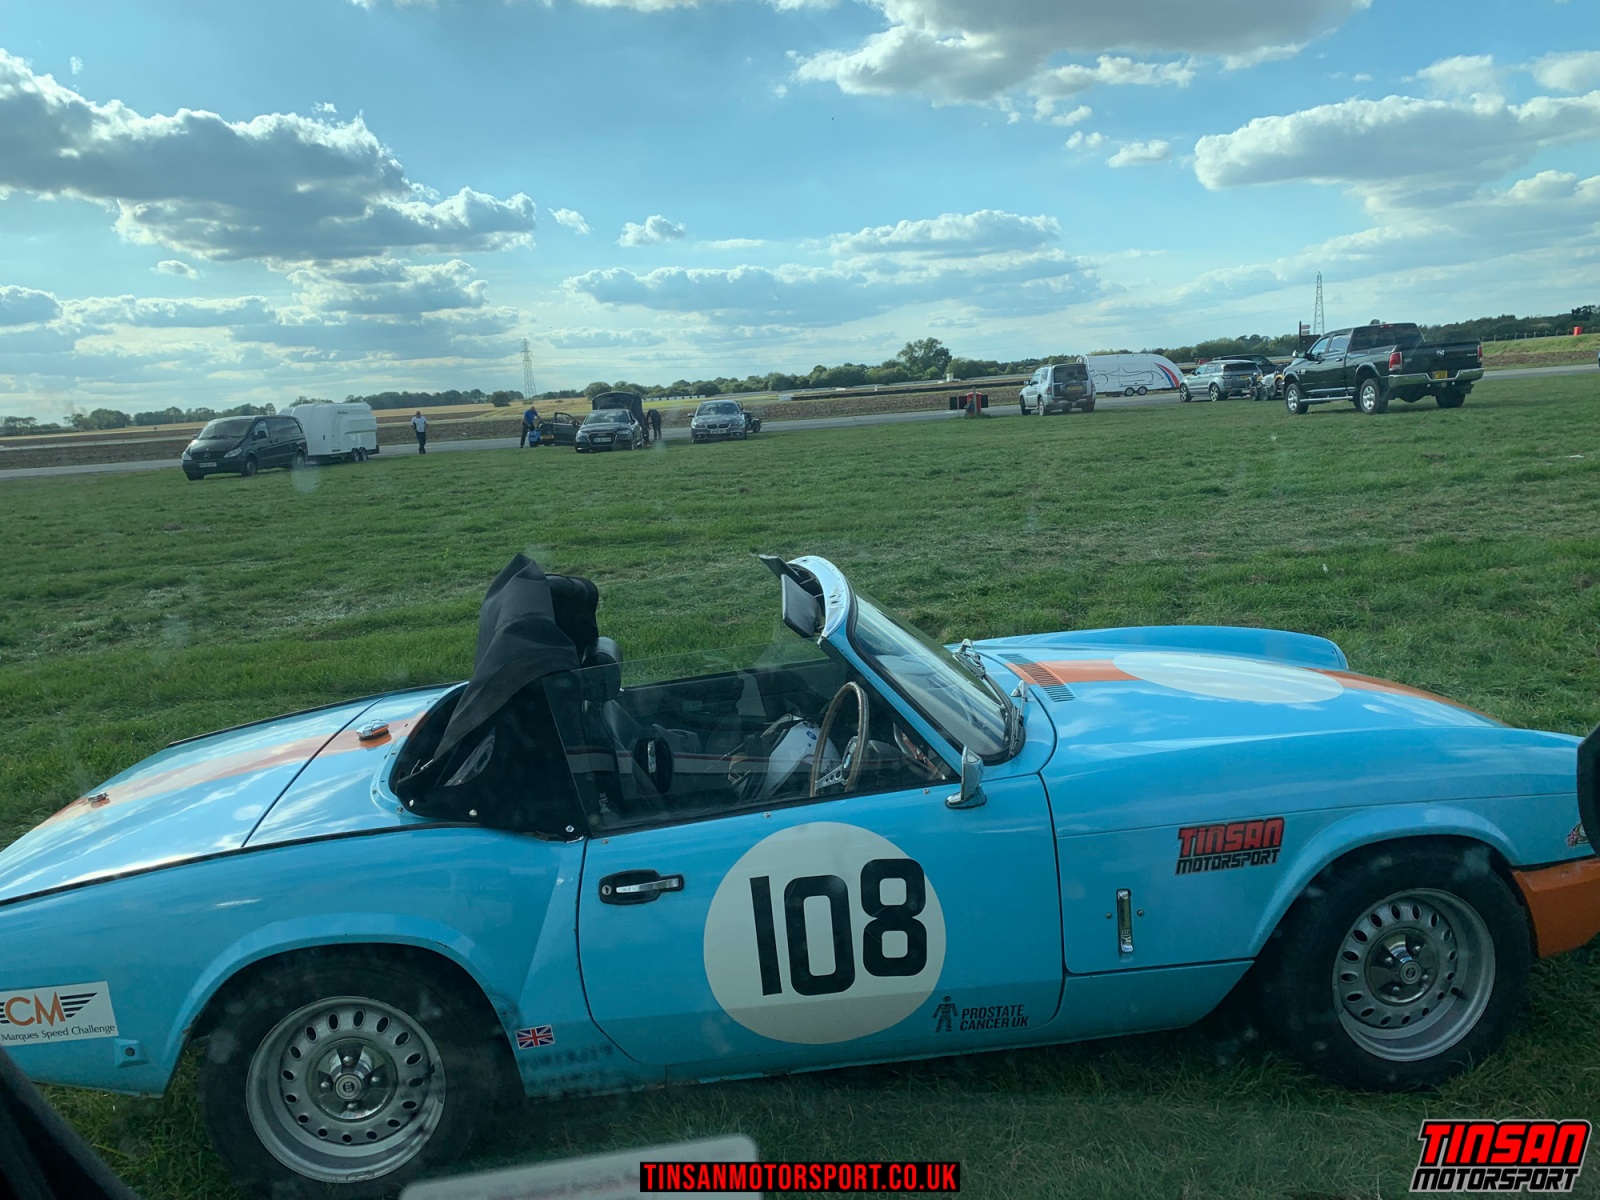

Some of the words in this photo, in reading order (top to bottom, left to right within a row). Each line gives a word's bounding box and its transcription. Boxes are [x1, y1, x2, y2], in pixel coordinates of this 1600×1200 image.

[1179, 818, 1284, 858] TINSAN
[1175, 848, 1280, 875] MOTORSPORT
[749, 858, 927, 996] 108
[5, 992, 66, 1027] CM
[961, 1004, 1025, 1019] PROSTATE
[1, 1032, 39, 1042] Marques
[41, 1027, 69, 1039] Speed
[71, 1024, 116, 1035] Challenge
[960, 1018, 1010, 1031] CANCER
[1011, 1016, 1029, 1028] UK
